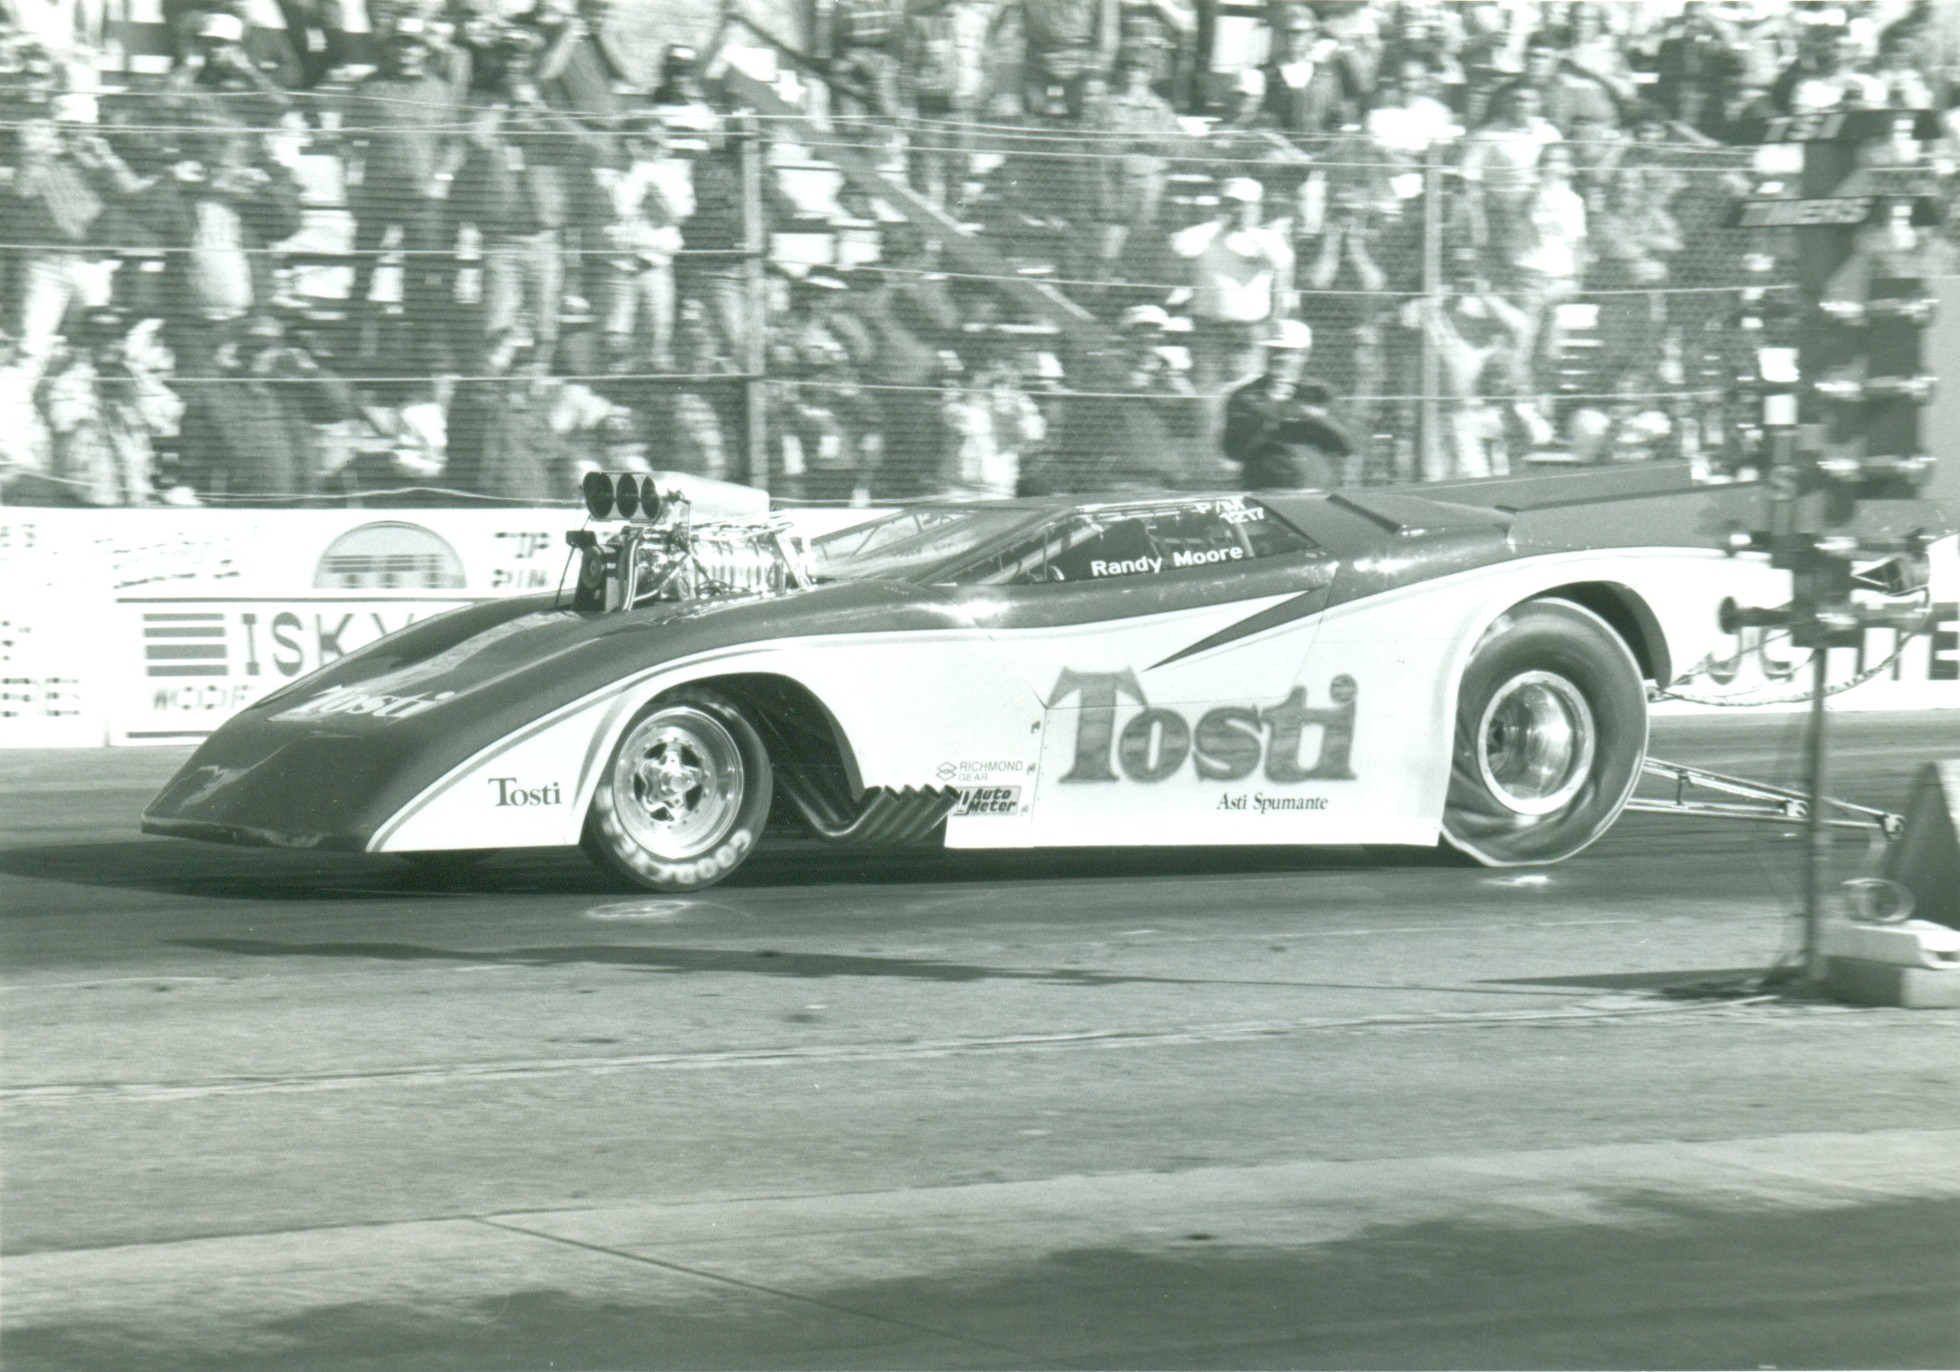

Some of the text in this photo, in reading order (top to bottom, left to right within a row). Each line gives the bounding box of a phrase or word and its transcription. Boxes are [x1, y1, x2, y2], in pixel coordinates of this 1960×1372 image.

[1091, 546, 1244, 577] Randy Moore
[1046, 666, 1359, 784] Tosti
[960, 761, 1023, 773] RICHMOND
[959, 773, 988, 782] GEAR
[487, 777, 563, 807] Tosti
[972, 788, 1012, 801] Auto
[967, 801, 1017, 813] Meter
[1216, 792, 1329, 815] Asti Spumante
